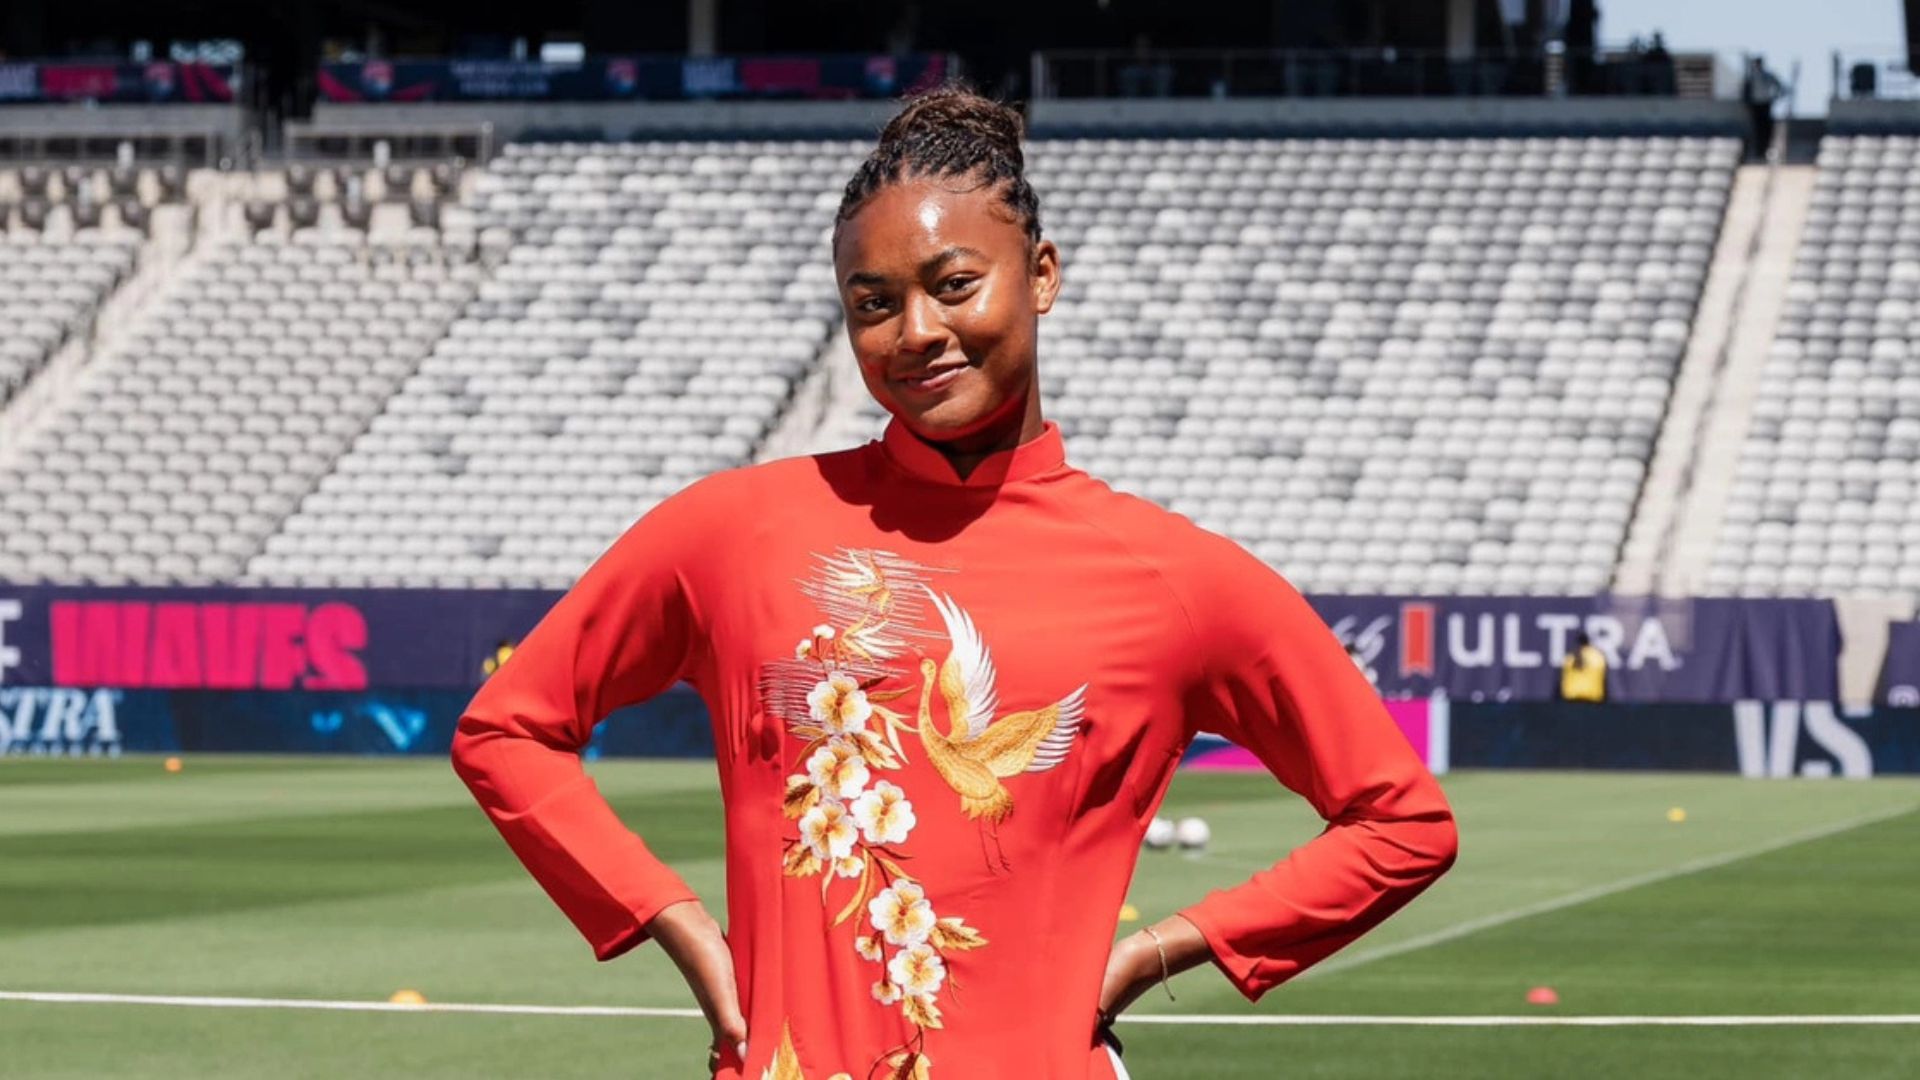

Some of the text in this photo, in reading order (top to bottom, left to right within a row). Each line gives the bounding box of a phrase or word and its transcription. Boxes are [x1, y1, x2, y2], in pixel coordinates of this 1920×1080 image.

[52, 602, 368, 690] WAVES
[1447, 612, 1679, 670] ULTRA
[1733, 699, 1873, 777] VS
